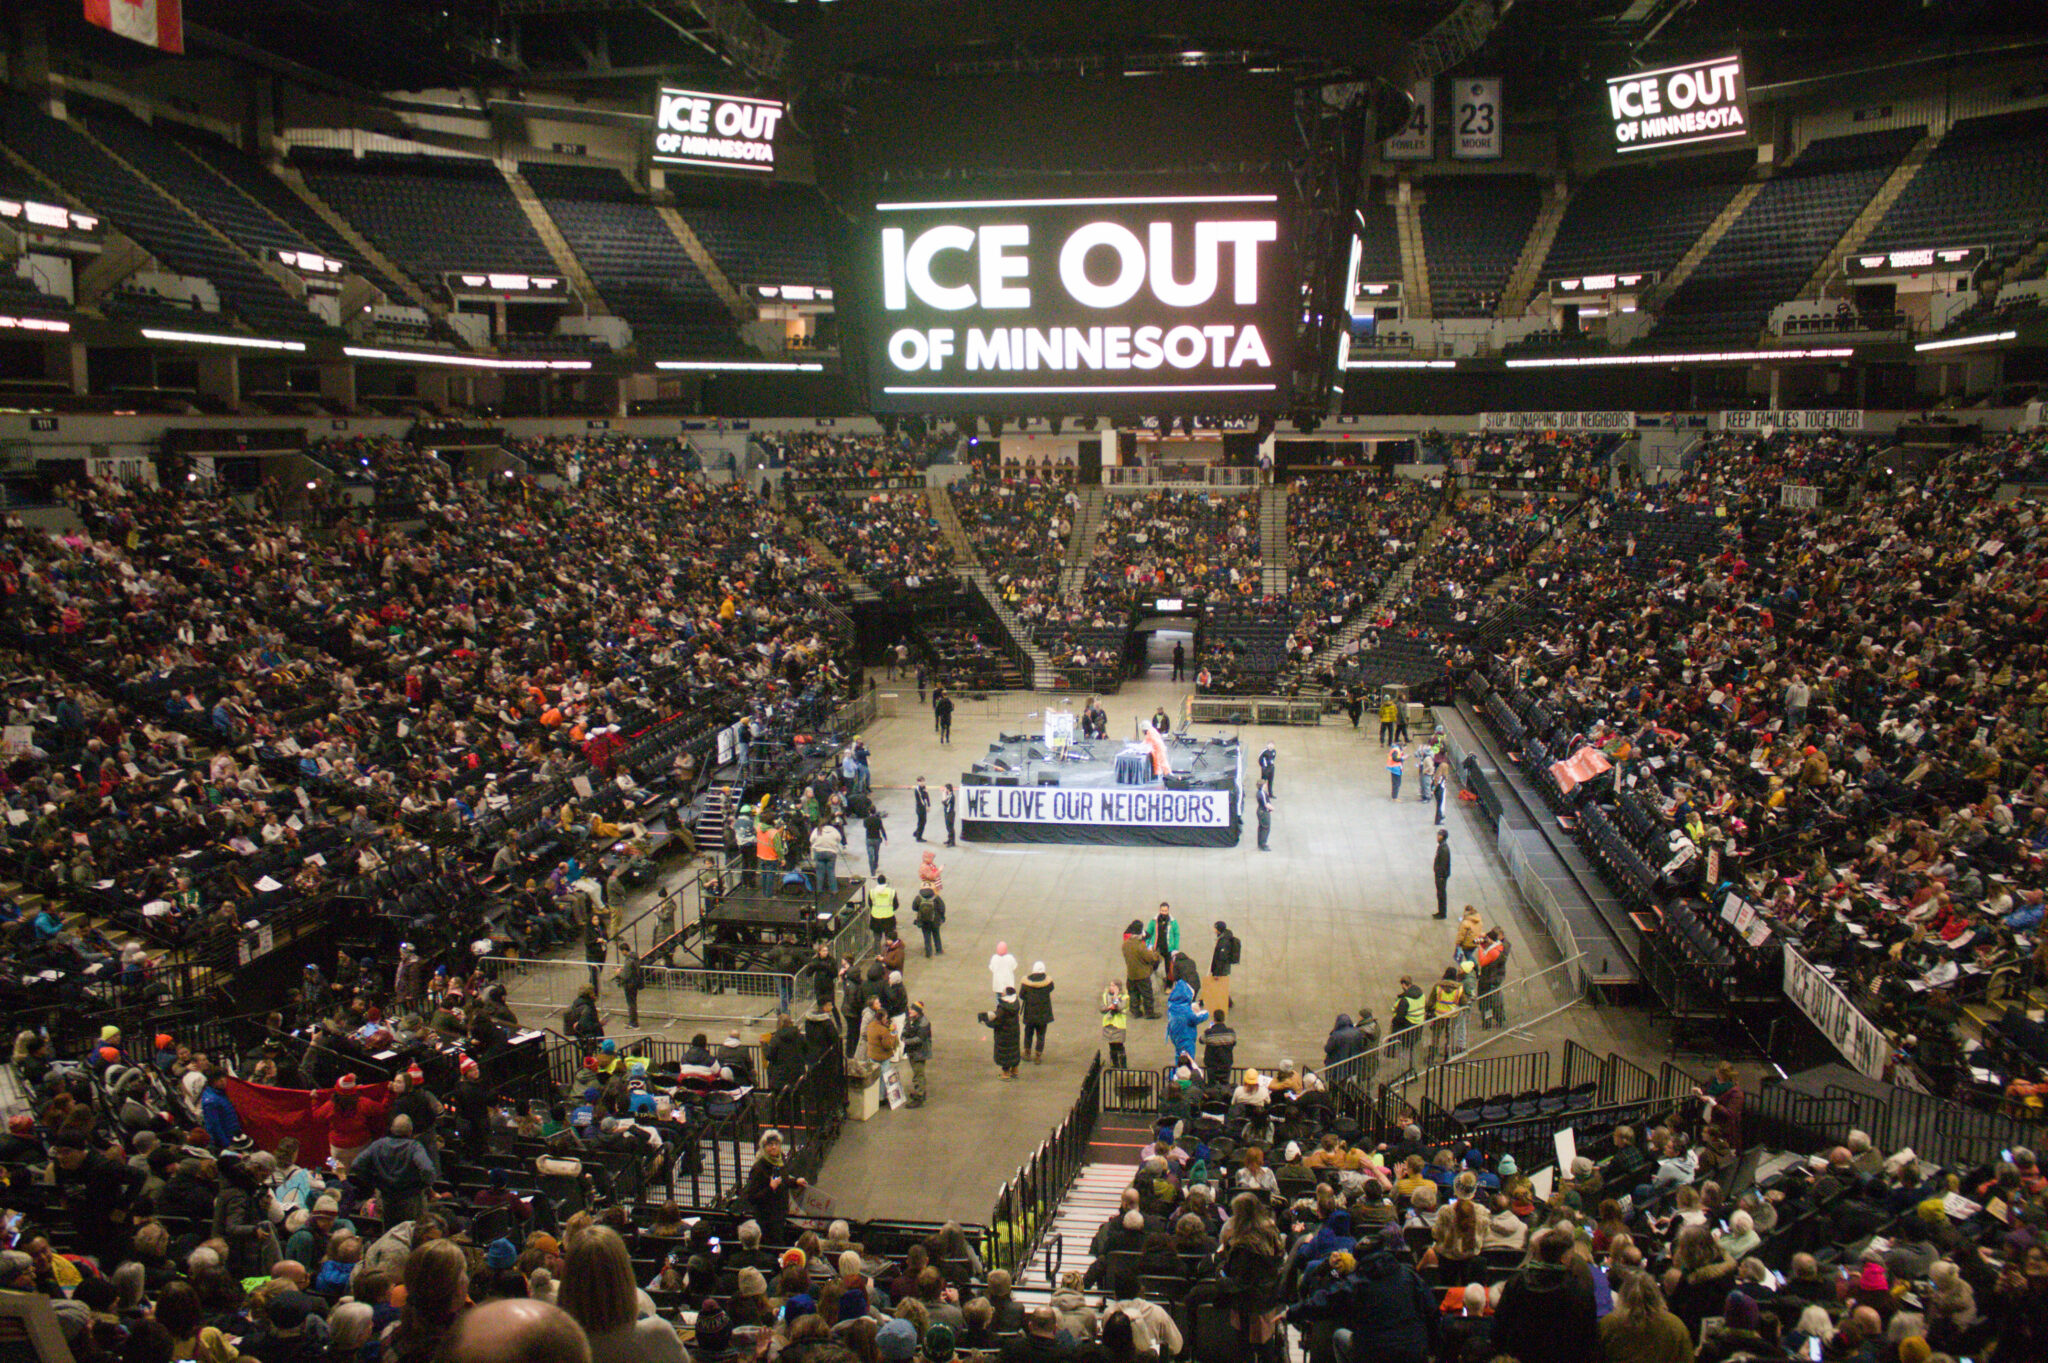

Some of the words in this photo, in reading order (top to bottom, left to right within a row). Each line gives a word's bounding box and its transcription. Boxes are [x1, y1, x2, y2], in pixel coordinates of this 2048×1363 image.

[1609, 79, 1661, 120] ICE
[1667, 64, 1739, 109] OUT
[658, 95, 711, 134] ICE
[715, 102, 782, 140] OUT
[1459, 103, 1495, 135] 23
[1616, 122, 1638, 142] OF
[1641, 106, 1743, 139] MINNESOTA
[656, 133, 681, 153] OF
[681, 135, 774, 162] MINNESOTA
[1461, 138, 1492, 148] MOORE
[882, 225, 1031, 310] ICE
[1059, 221, 1277, 308] OUT
[888, 327, 955, 371] OF
[965, 324, 1272, 370] MINNESOTA
[1486, 414, 1506, 427] STOP
[1509, 413, 1557, 427] KIDNAPPING
[1560, 413, 1578, 427] OUR
[1580, 412, 1629, 427] NEIGHBORS
[1726, 412, 1751, 428] KEEP
[1754, 412, 1799, 428] FAMILIES
[1804, 411, 1859, 428] TOGETHER
[967, 789, 991, 818] WE
[998, 790, 1047, 820] LOVE
[1053, 792, 1093, 821] OUR
[1100, 794, 1222, 823] NEIGHBORS.
[1811, 973, 1835, 1034] OUT
[1834, 1001, 1853, 1051] OF
